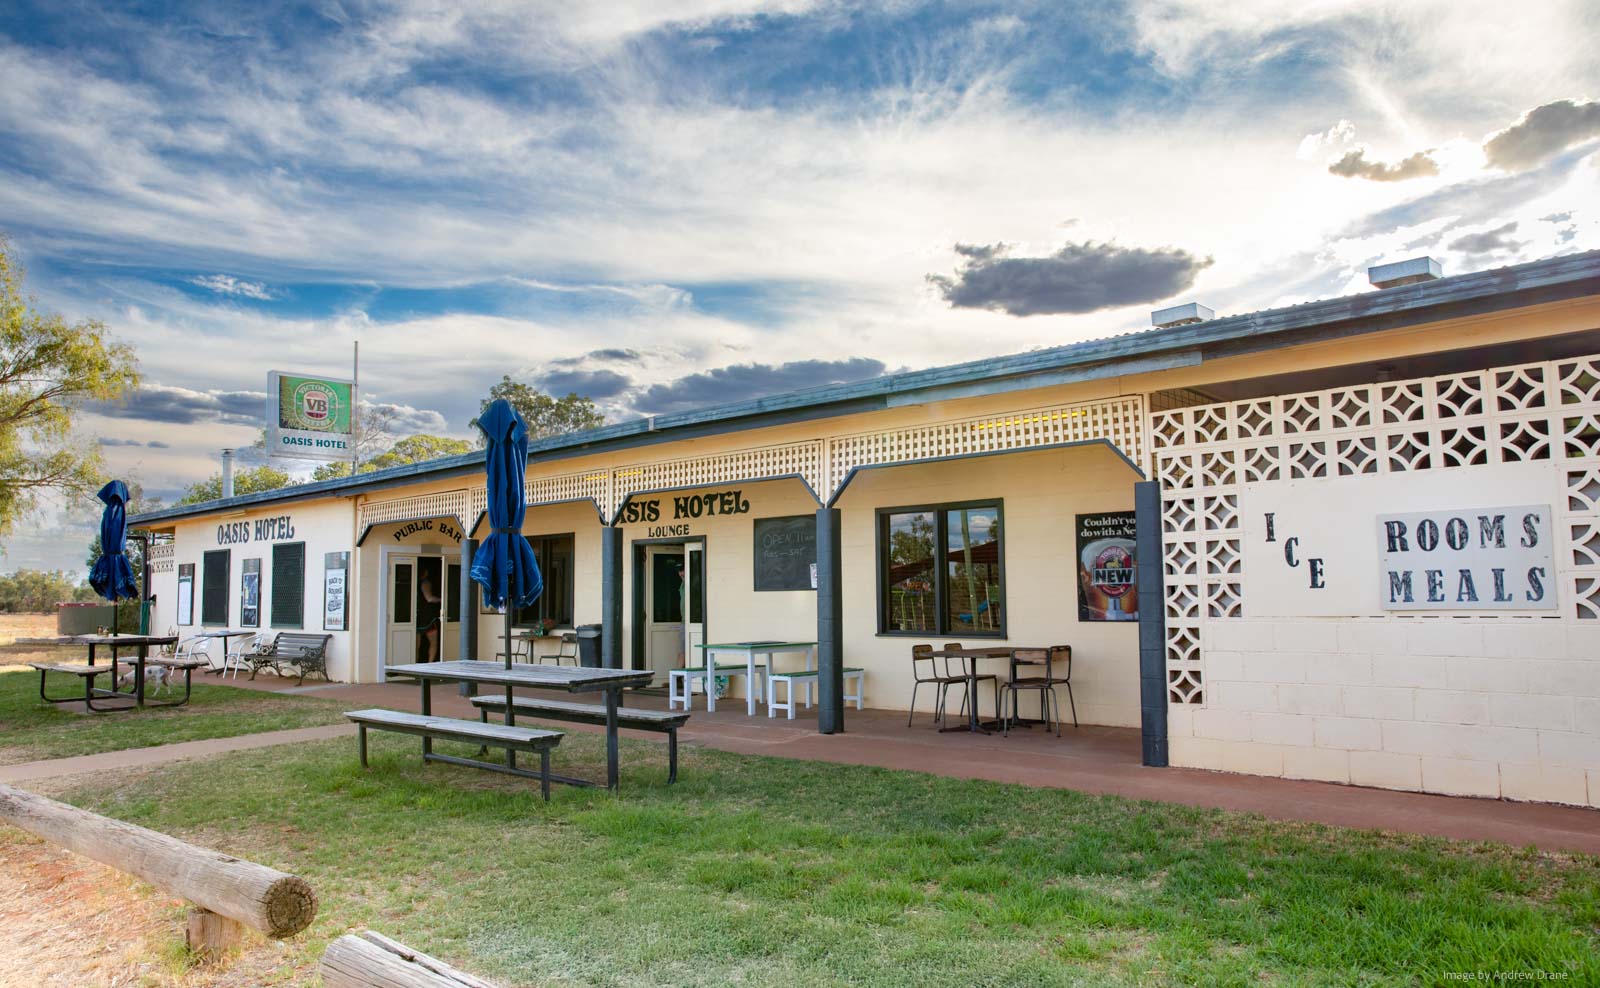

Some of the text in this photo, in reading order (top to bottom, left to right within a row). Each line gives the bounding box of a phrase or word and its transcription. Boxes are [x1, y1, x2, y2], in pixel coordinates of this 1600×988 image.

[306, 399, 328, 412] VB
[282, 436, 348, 449] OASIS HOTEL
[599, 490, 750, 526] ASIS HOTEL
[217, 516, 295, 545] OASIS HOTEL
[1084, 516, 1123, 527] Couldn't
[393, 520, 462, 543] PUBLIC BAR
[648, 524, 690, 538] LOUNGE
[1081, 528, 1093, 537] do
[1093, 527, 1115, 537] with
[1383, 513, 1541, 552] ROOMS
[1264, 512, 1325, 589] ICE
[1095, 569, 1133, 583] NEW
[1387, 567, 1546, 603] MEALS
